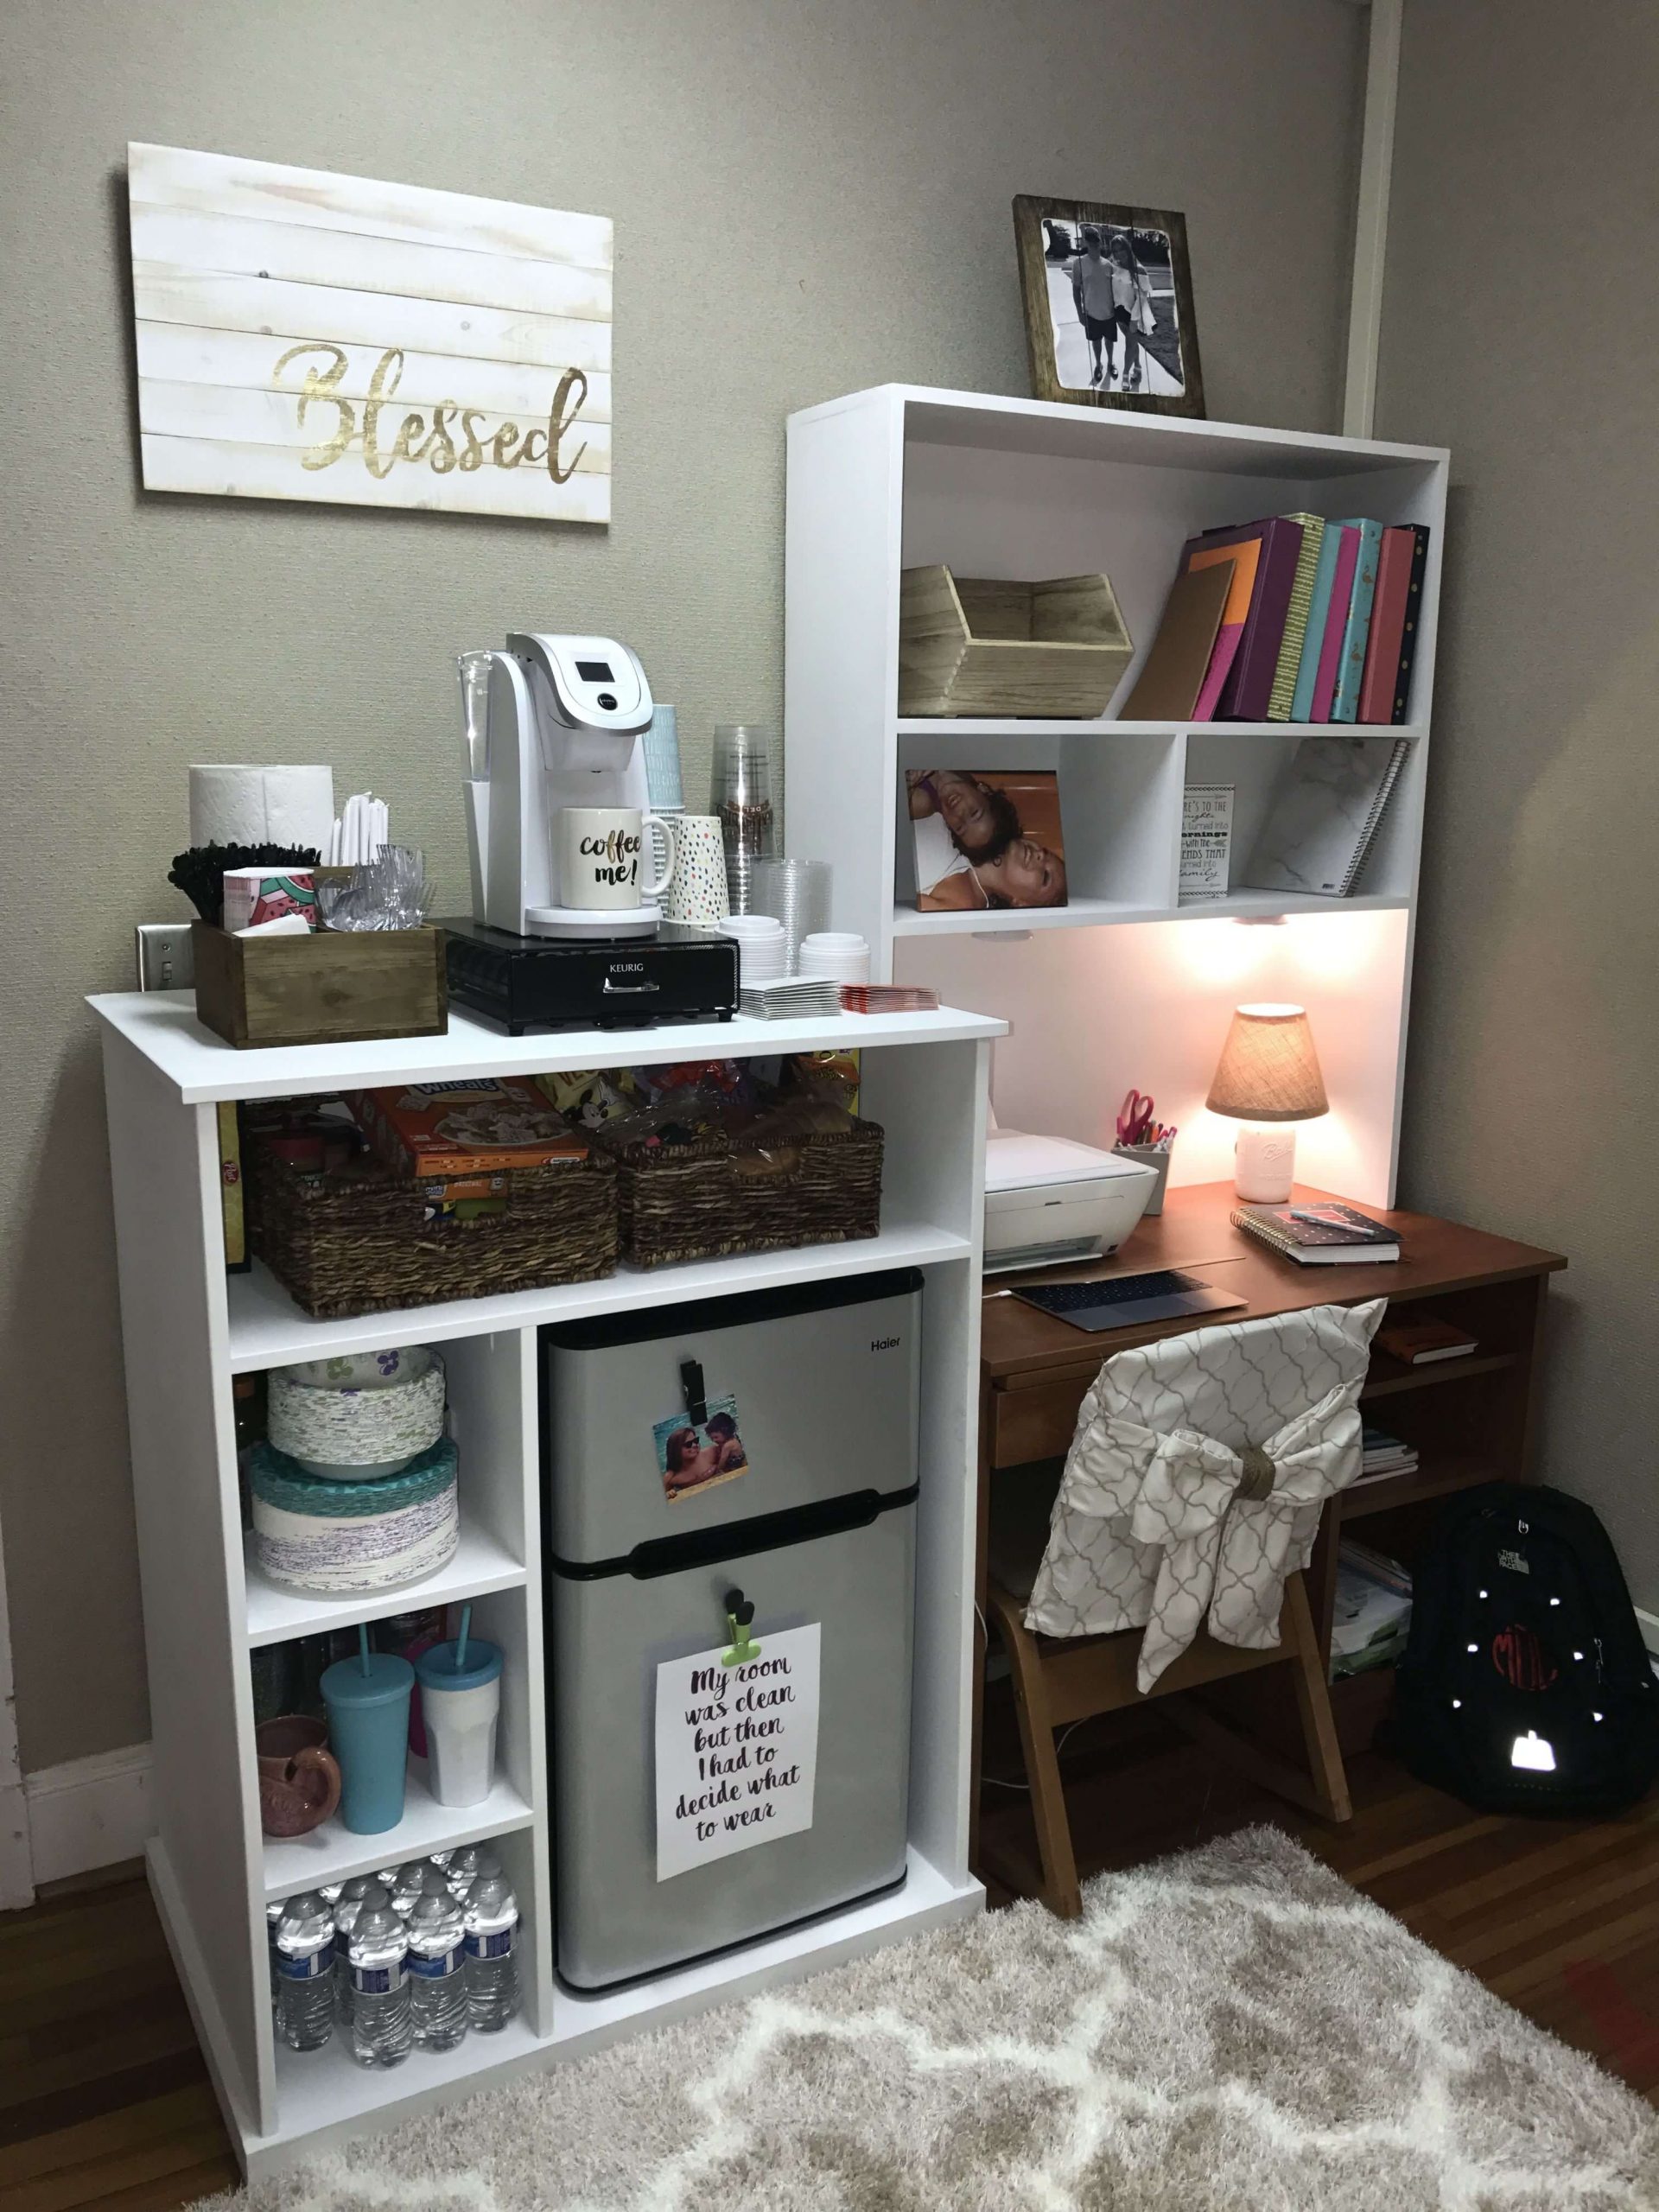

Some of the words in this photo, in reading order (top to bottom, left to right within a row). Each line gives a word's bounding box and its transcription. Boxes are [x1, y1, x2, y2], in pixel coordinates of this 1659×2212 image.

[272, 343, 588, 485] Blessed
[1182, 801, 1199, 812] RE'S
[1202, 801, 1211, 812] TO
[1214, 801, 1226, 812] THE
[580, 830, 641, 864] coffee
[1181, 850, 1203, 860] ENDS
[1205, 849, 1226, 859] THAT
[595, 859, 638, 886] me!
[610, 963, 644, 973] KEURIG
[871, 1338, 900, 1351] Haier
[691, 1667, 729, 1700] My
[734, 1656, 791, 1682] room
[685, 1700, 729, 1726] was
[735, 1685, 796, 1713] clean
[694, 1728, 732, 1753] but
[734, 1716, 785, 1743] then
[698, 1758, 706, 1781] I
[709, 1746, 752, 1777] had
[755, 1746, 779, 1765] to
[675, 1780, 741, 1820] decide
[747, 1765, 800, 1795] what
[695, 1819, 719, 1841] to
[723, 1802, 777, 1831] wear
